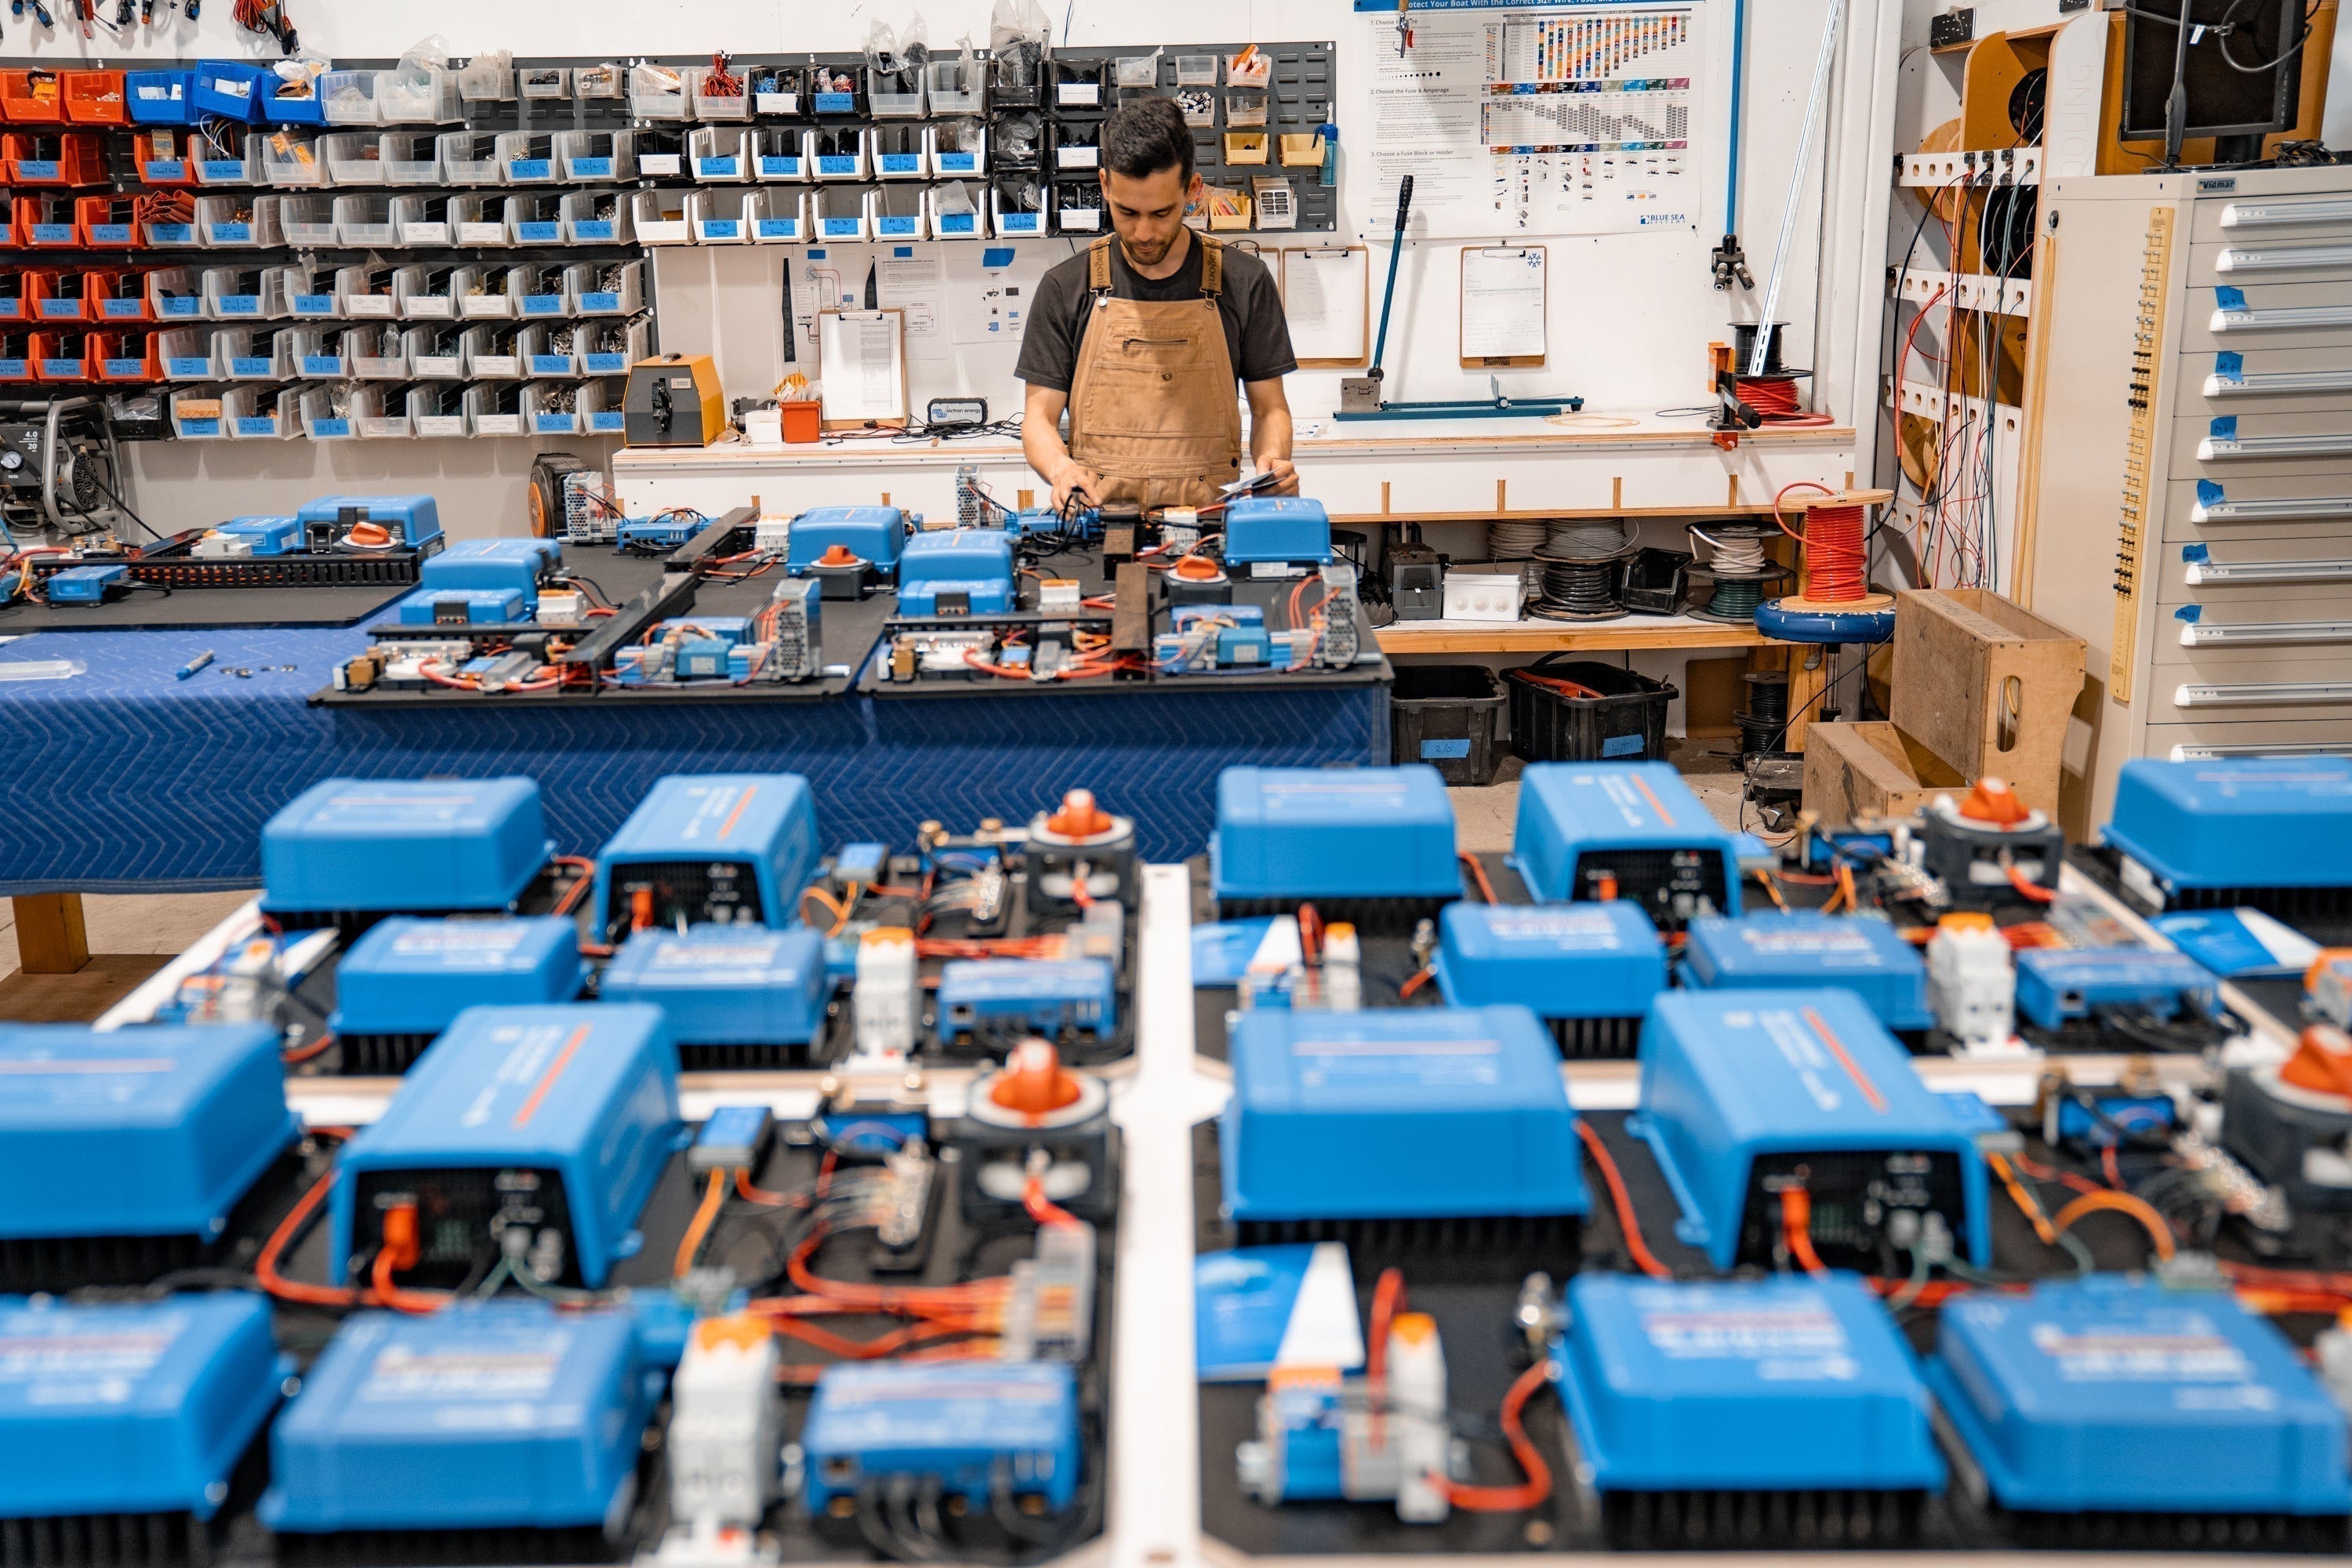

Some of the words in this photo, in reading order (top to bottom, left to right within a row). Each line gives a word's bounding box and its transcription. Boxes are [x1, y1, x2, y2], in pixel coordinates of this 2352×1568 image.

[2060, 65, 2091, 176] OOLING
[1094, 249, 1105, 287] tagoni
[1207, 250, 1217, 289] tagoni
[597, 417, 609, 425] 4/0
[1436, 743, 1452, 753] 2/0
[1612, 742, 1629, 752] 4/0
